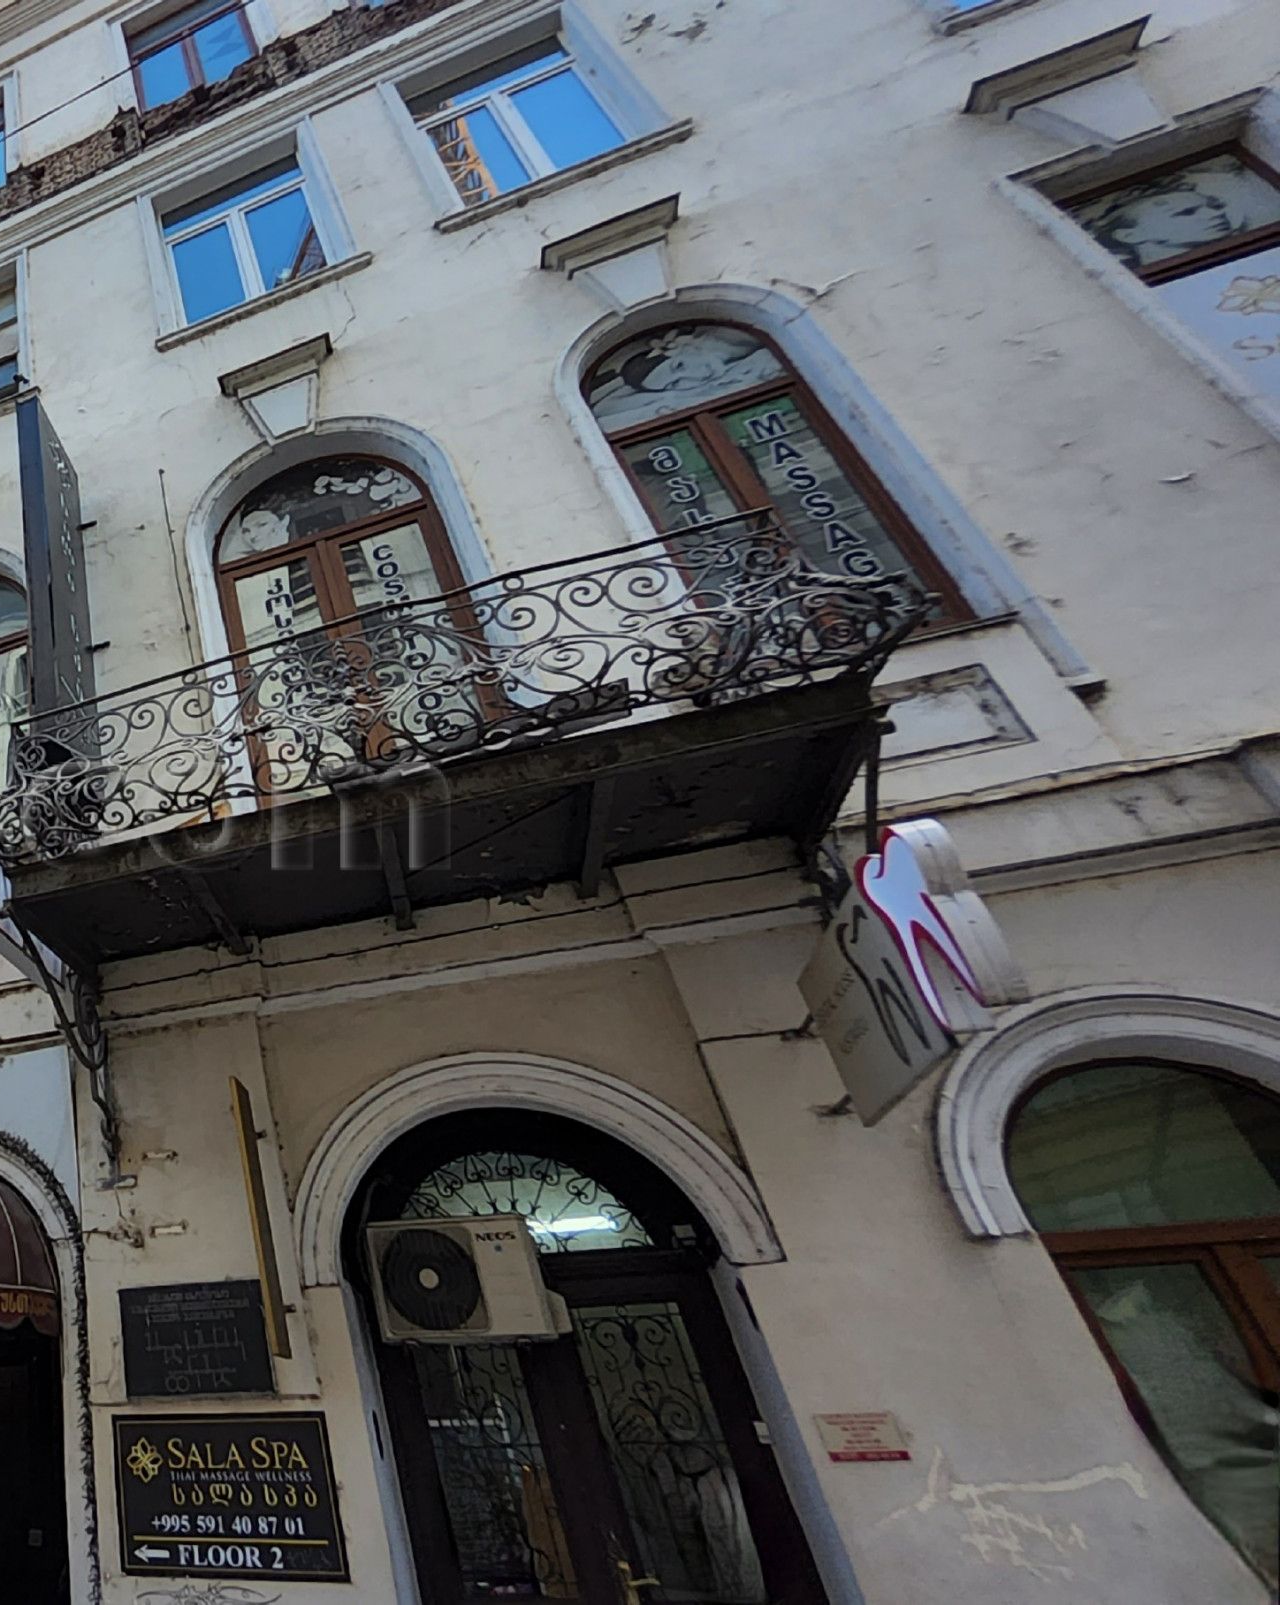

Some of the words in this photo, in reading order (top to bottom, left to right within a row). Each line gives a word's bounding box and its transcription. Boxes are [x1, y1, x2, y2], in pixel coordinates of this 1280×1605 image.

[251, 1436, 310, 1470] SPA
[170, 1471, 197, 1481] THAI
[200, 1471, 250, 1482] MASSAGE
[255, 1471, 312, 1482] WELLNESS
[151, 1514, 191, 1534] +995
[196, 1515, 225, 1534] 591
[231, 1516, 252, 1535] 40
[258, 1516, 277, 1535] 87
[284, 1517, 305, 1536] 01
[178, 1544, 263, 1569] FLOOR
[271, 1547, 285, 1570] 2
